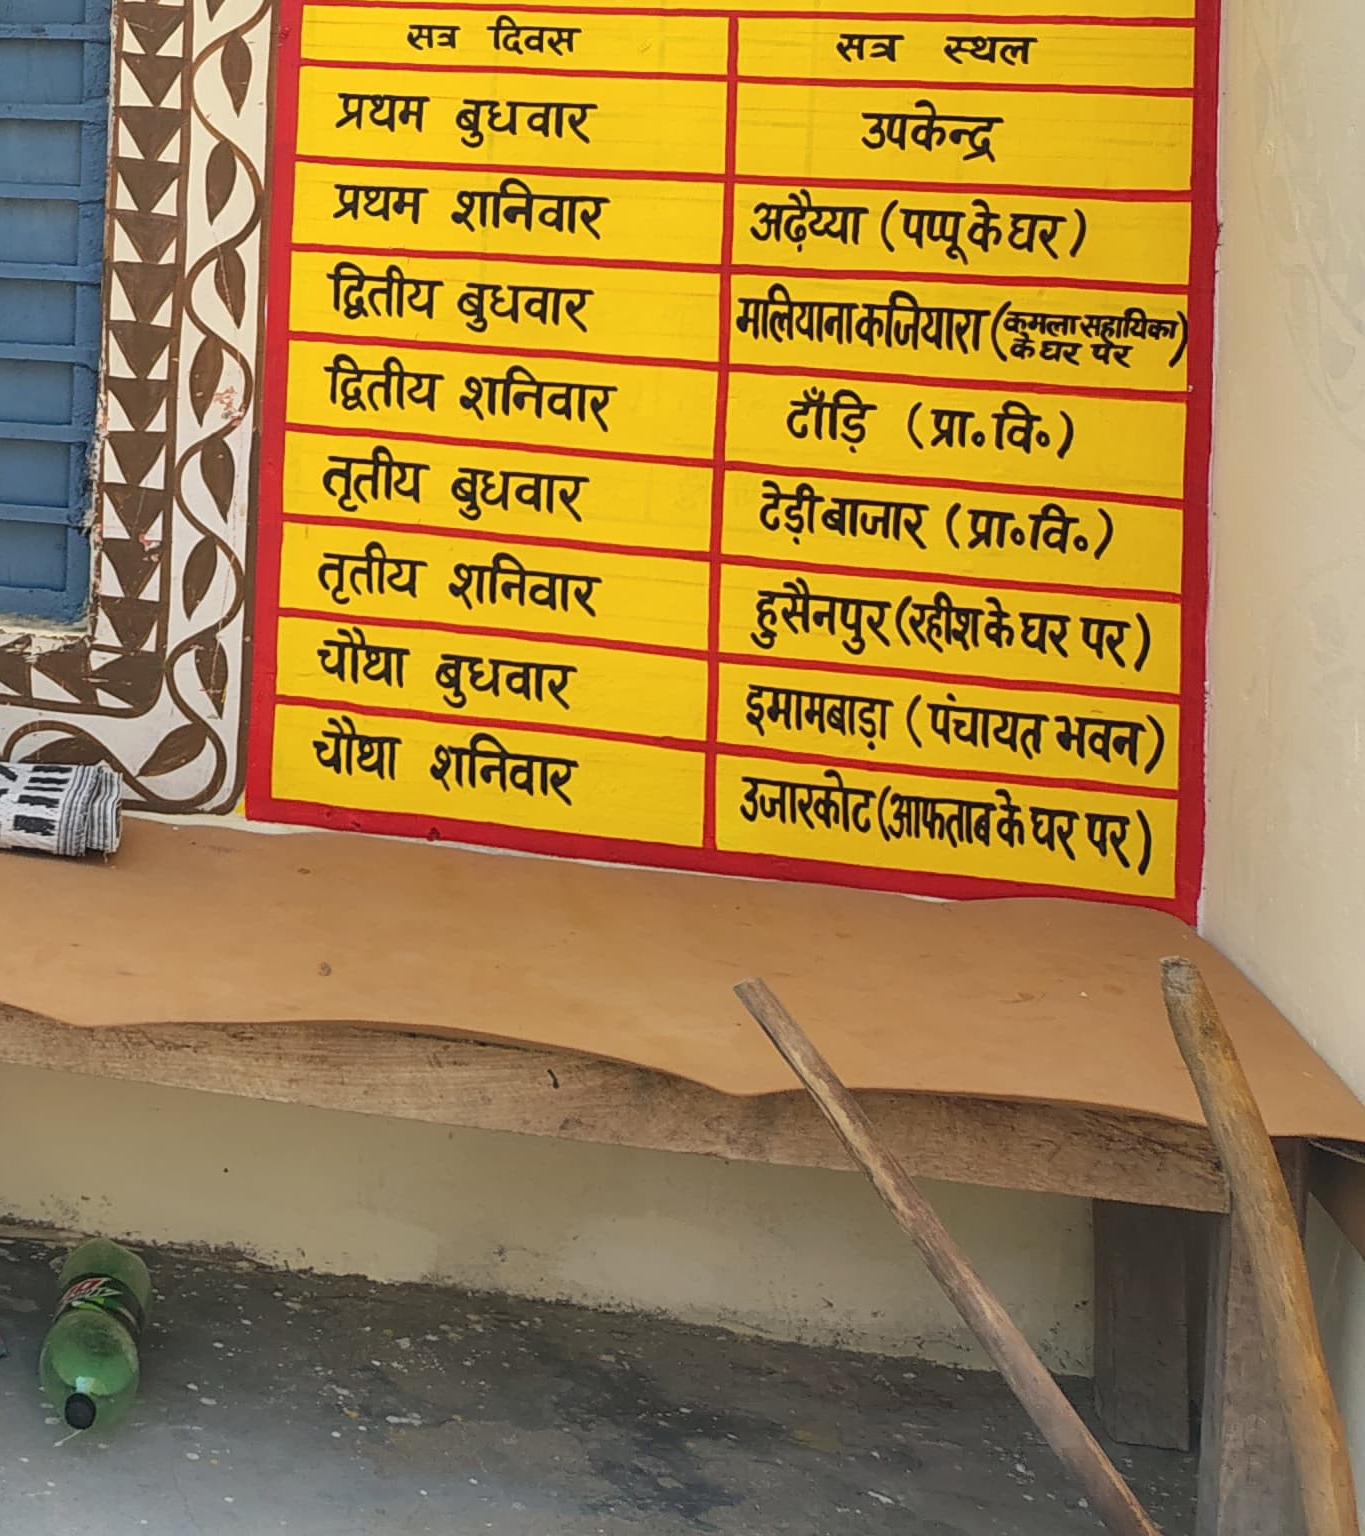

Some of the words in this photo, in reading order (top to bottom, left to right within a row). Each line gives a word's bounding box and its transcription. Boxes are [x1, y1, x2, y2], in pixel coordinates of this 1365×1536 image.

[407, 24, 460, 50] सत्र
[487, 15, 581, 55] दिवस
[837, 33, 903, 63] सत्र
[944, 35, 1037, 66] स्थल
[335, 92, 430, 132] प्रथम
[455, 98, 598, 148] बुधवार
[861, 99, 1003, 162] उपकेन्द्र
[333, 183, 429, 225] प्रथम
[451, 177, 611, 240] शनिवार
[326, 261, 444, 320] द्वितीय
[456, 281, 594, 333] बुधवार
[324, 353, 444, 412] द्वितीय
[459, 364, 618, 432] शनिवार
[322, 445, 430, 512] तृतीय
[451, 466, 590, 522] बुधवार
[318, 541, 428, 605] तृतीय
[448, 552, 603, 617] शनिवार
[317, 626, 410, 688] चौथा
[435, 652, 578, 710] बुधवार
[745, 684, 894, 751] इमामबाड़ा
[313, 715, 401, 780] चौथा
[429, 732, 579, 807] शनिवार
